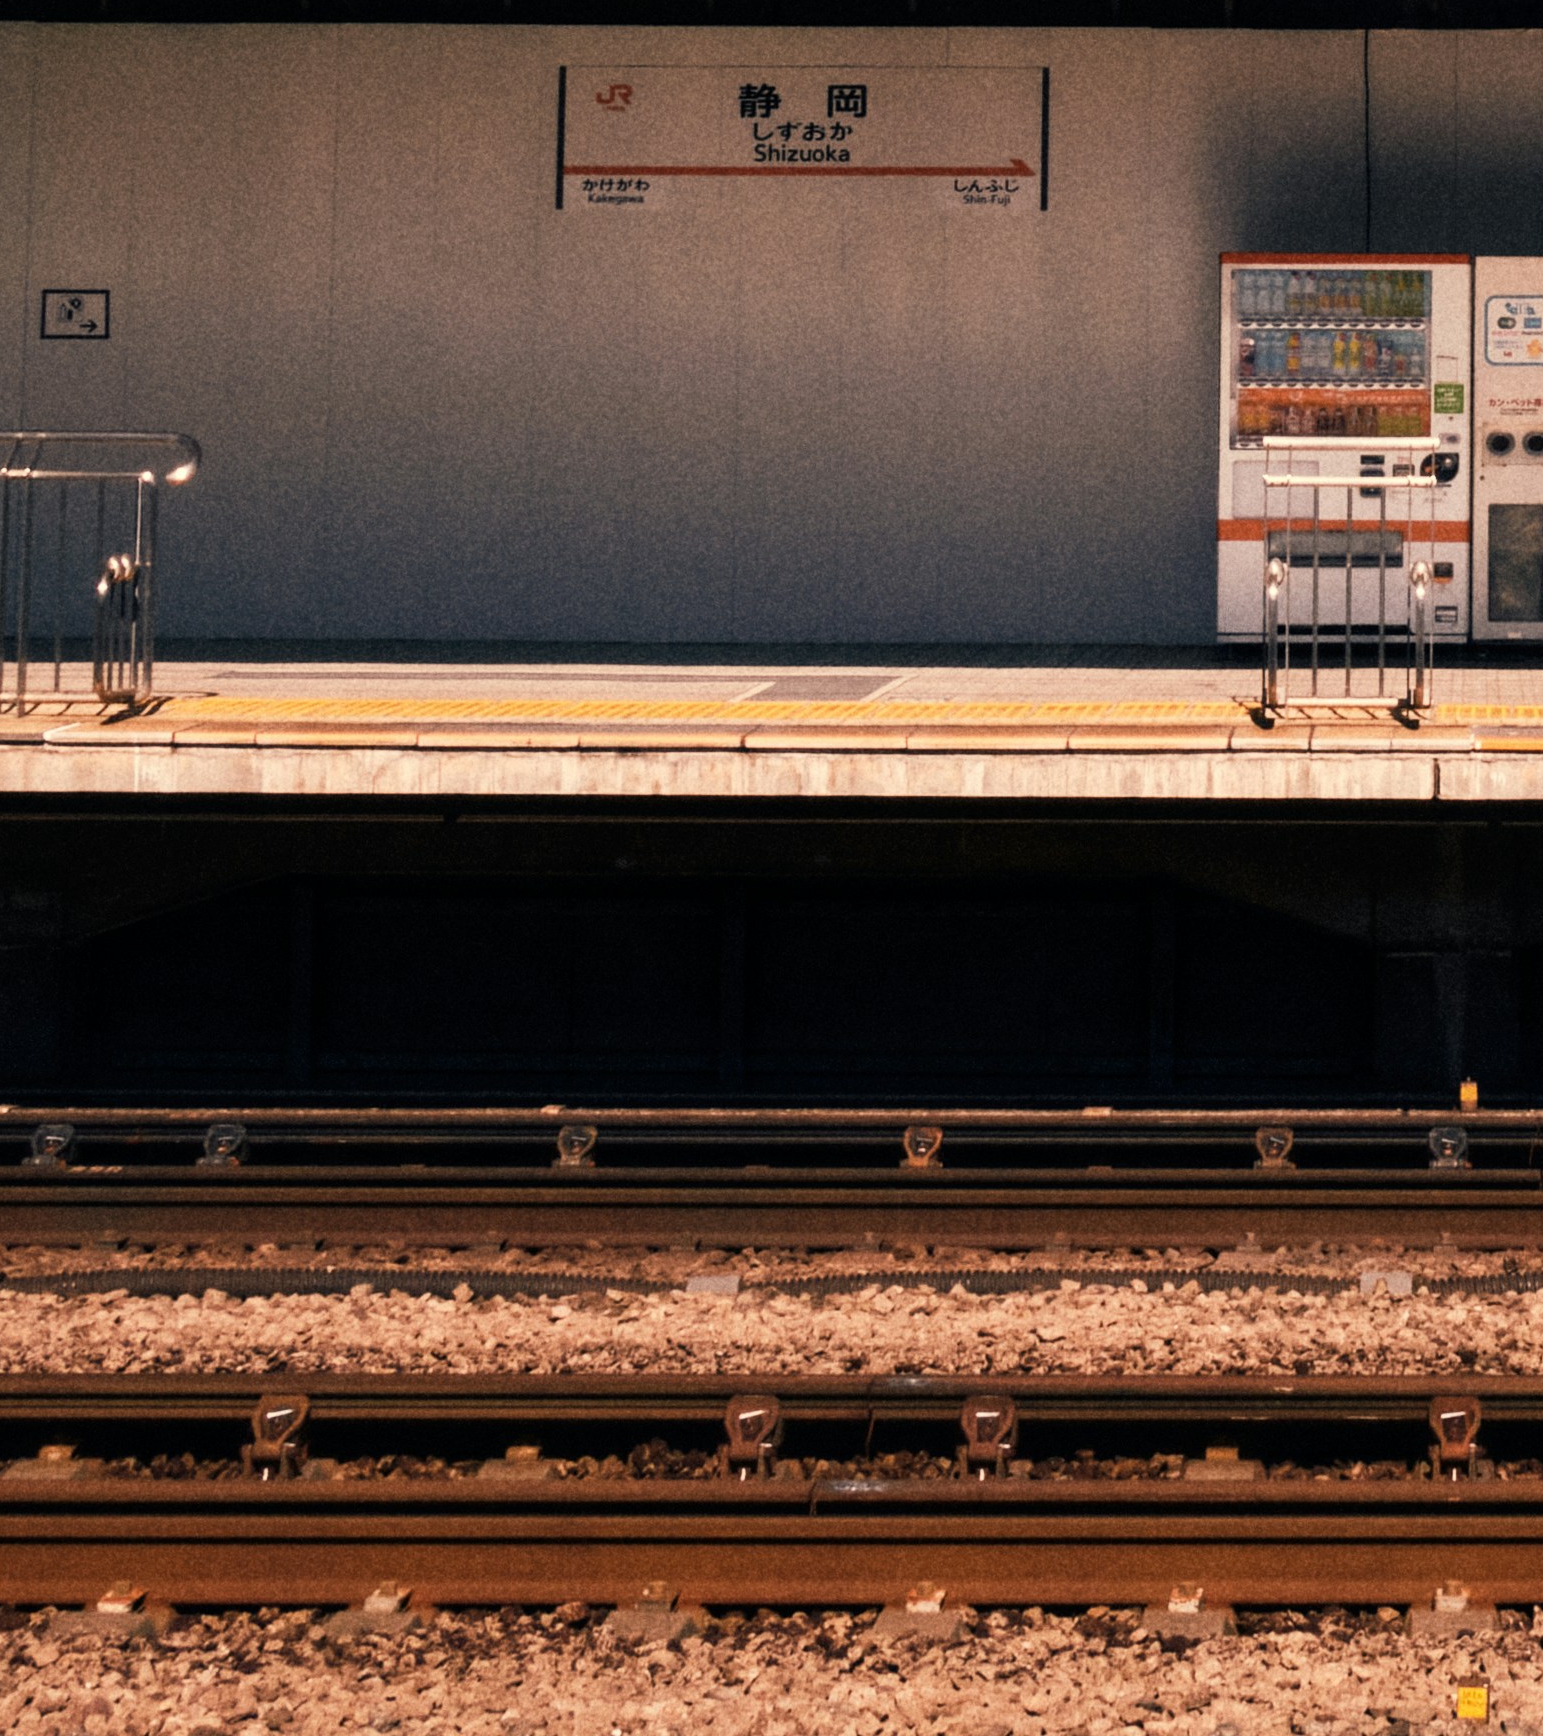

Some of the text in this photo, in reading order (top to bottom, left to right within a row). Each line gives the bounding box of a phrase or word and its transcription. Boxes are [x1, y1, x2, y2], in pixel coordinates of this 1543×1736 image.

[595, 83, 634, 105] JR
[738, 83, 868, 118] 静岡
[753, 121, 853, 141] しずおか
[754, 144, 850, 162] Shizuoka
[582, 178, 651, 192] かけがわ
[953, 179, 1020, 193] しんふじ
[587, 194, 645, 205] Kakegawa
[963, 194, 1011, 207] Shin-Fuji
